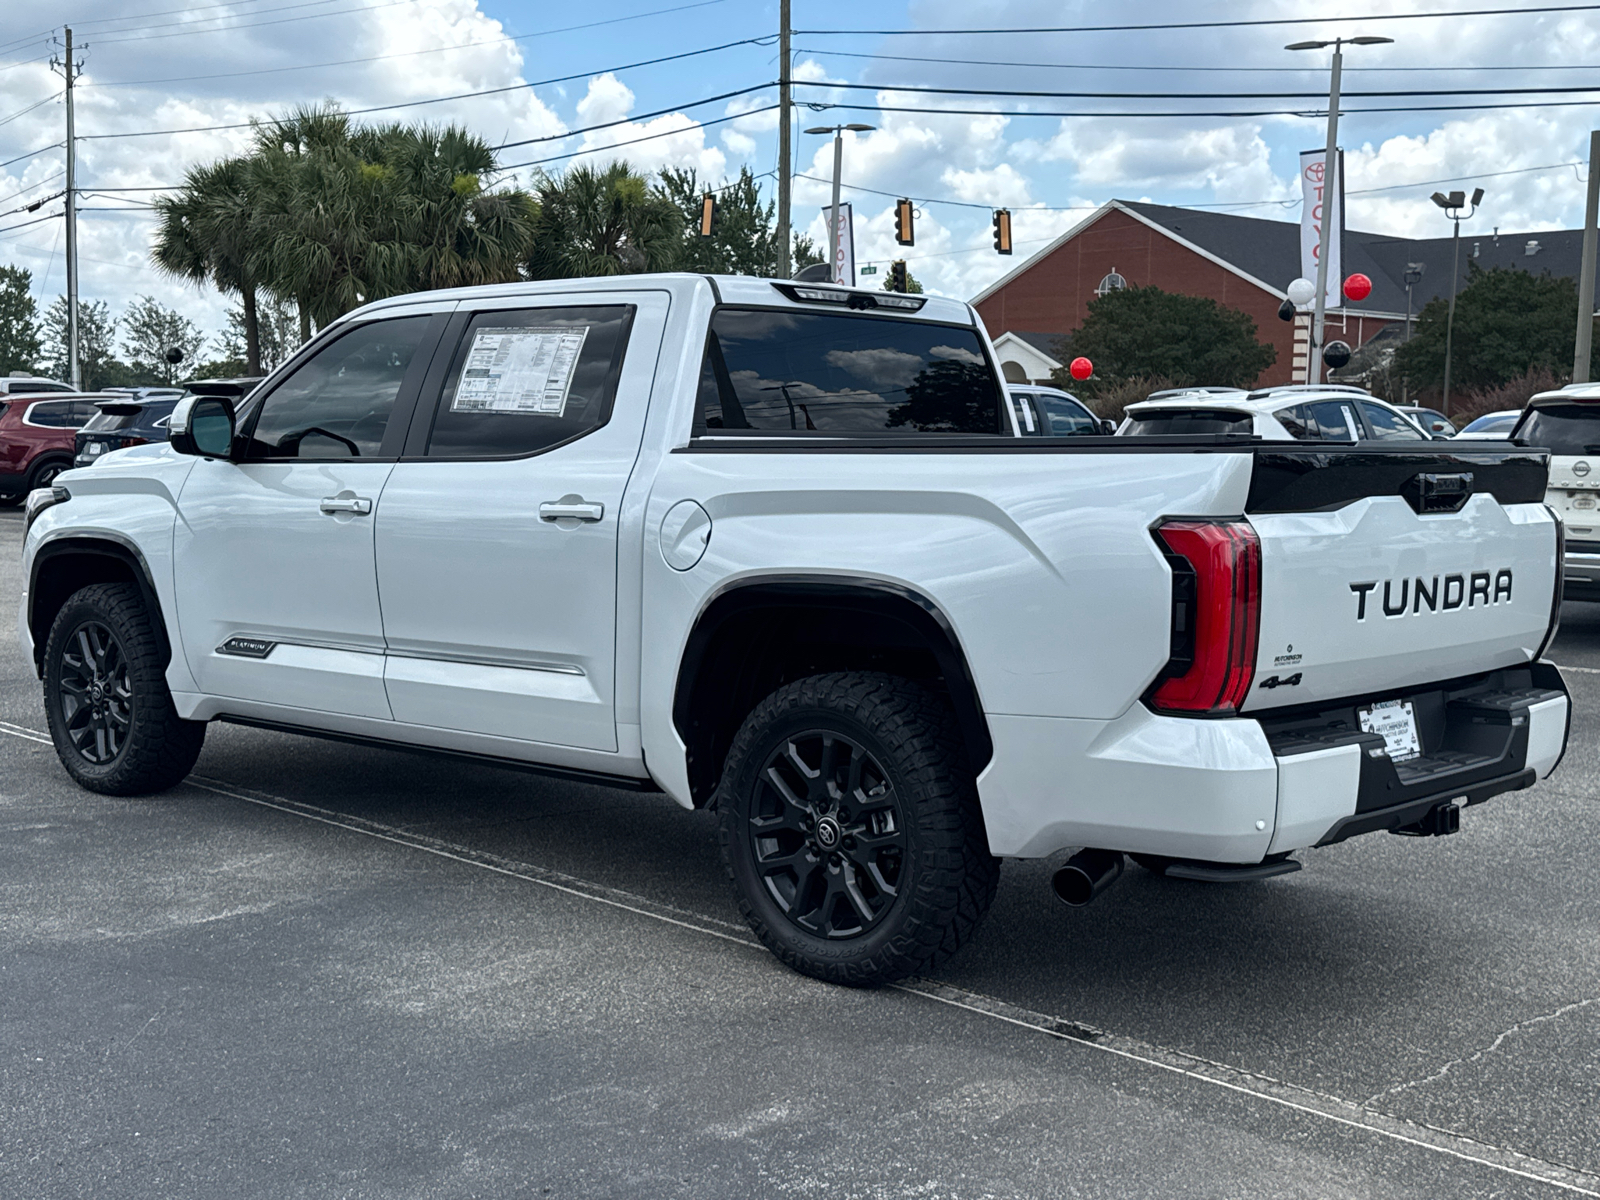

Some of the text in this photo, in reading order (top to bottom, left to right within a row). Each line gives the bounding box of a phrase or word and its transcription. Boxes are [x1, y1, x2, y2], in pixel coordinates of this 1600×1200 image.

[1312, 186, 1328, 297] TOYO
[1349, 568, 1513, 622] TUNDRA
[231, 640, 265, 650] PLATINUM
